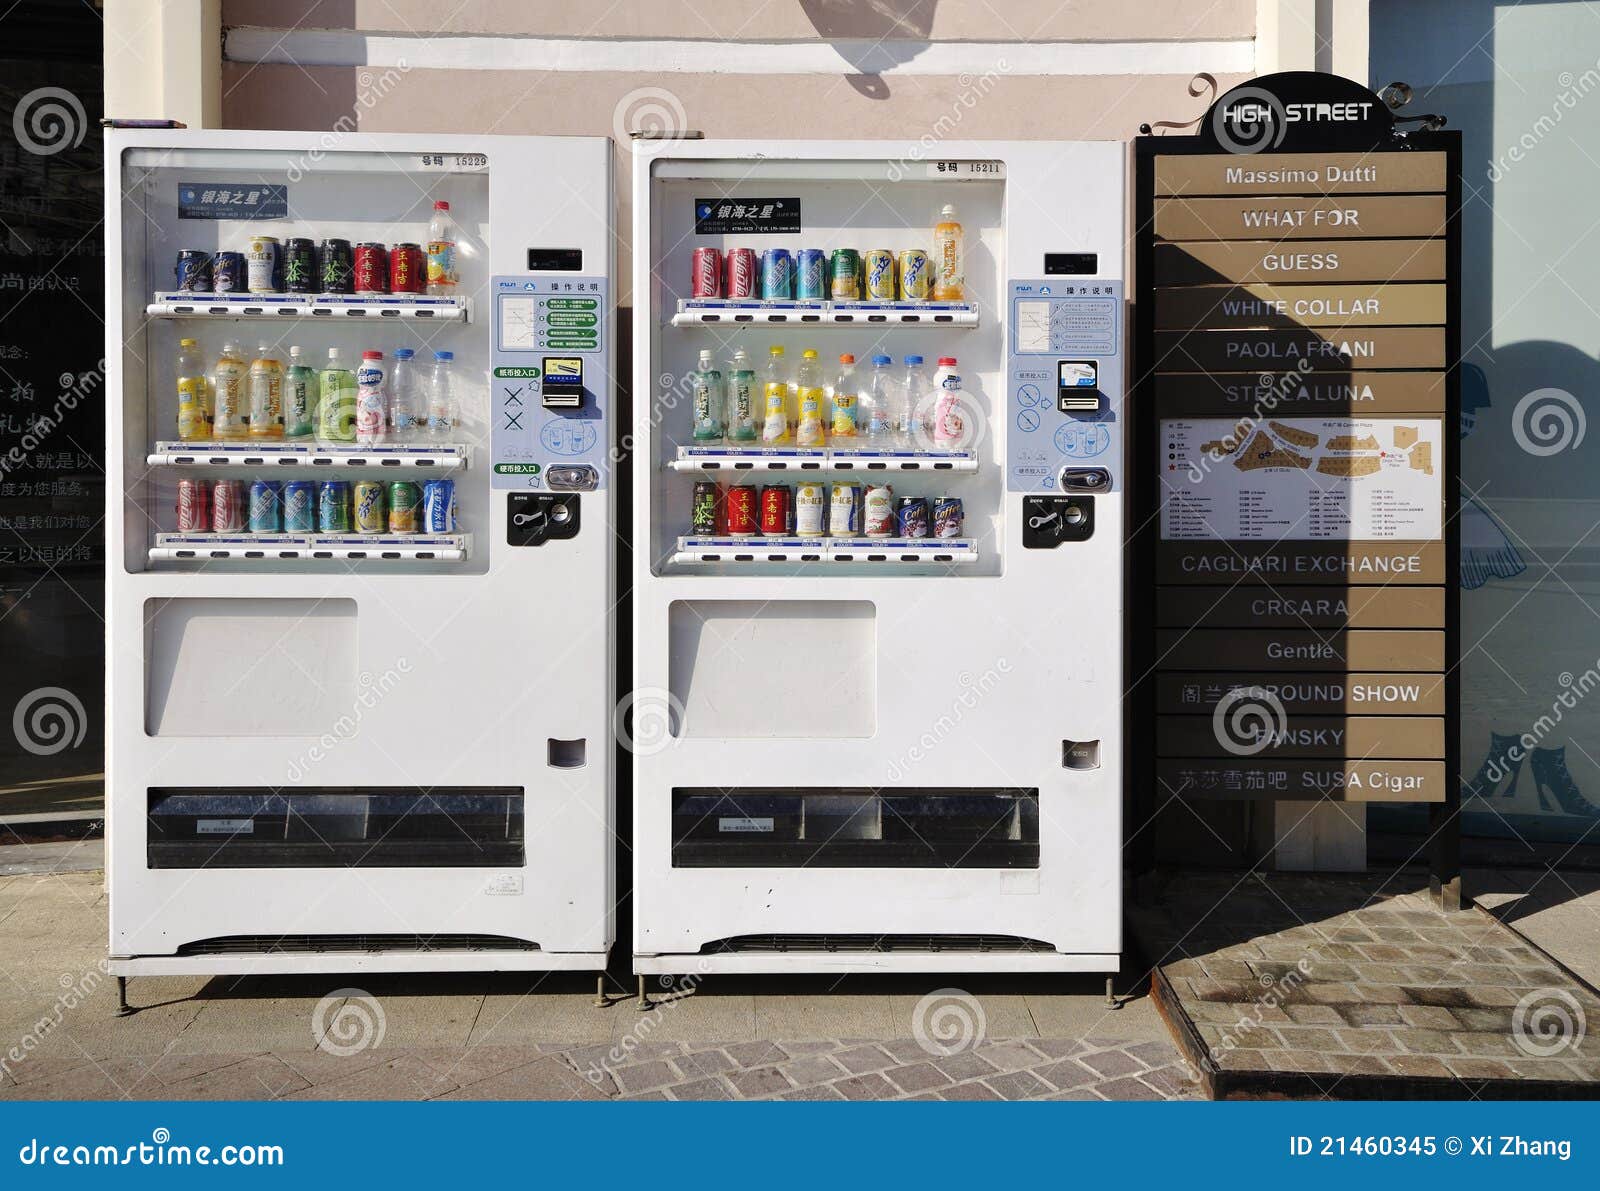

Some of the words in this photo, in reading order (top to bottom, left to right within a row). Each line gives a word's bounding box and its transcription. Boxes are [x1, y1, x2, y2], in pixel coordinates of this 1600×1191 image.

[1223, 104, 1272, 123] HIGH
[1285, 102, 1373, 122] STREET
[455, 157, 487, 167] 15229
[936, 162, 958, 173] 号码
[970, 163, 1000, 173] 15211
[1226, 167, 1319, 184] Massimo
[1326, 166, 1377, 182] Dutti
[200, 190, 261, 205] 银海之星
[717, 204, 774, 219] 银海之星
[1241, 210, 1306, 227] WHAT
[1314, 209, 1359, 226] FOR
[398, 250, 408, 285] 王老吉
[1263, 253, 1339, 270] GUESS
[551, 282, 598, 291] 操作说明
[1066, 287, 1113, 295] 操作说明
[1223, 300, 1287, 317] WHITE
[1294, 299, 1380, 316] COLLAR
[1227, 342, 1300, 358] PAOLA
[1307, 340, 1375, 357] FRANI
[738, 492, 749, 526] 王老吉
[767, 492, 777, 526] 王老吉
[1181, 556, 1288, 572] CAGLIARI
[1295, 556, 1421, 572] EXCHANGE
[1267, 642, 1334, 659] Gentle
[1352, 685, 1421, 702] SHOW
[1301, 771, 1362, 788] SUSA
[1368, 771, 1424, 792] Cigar
